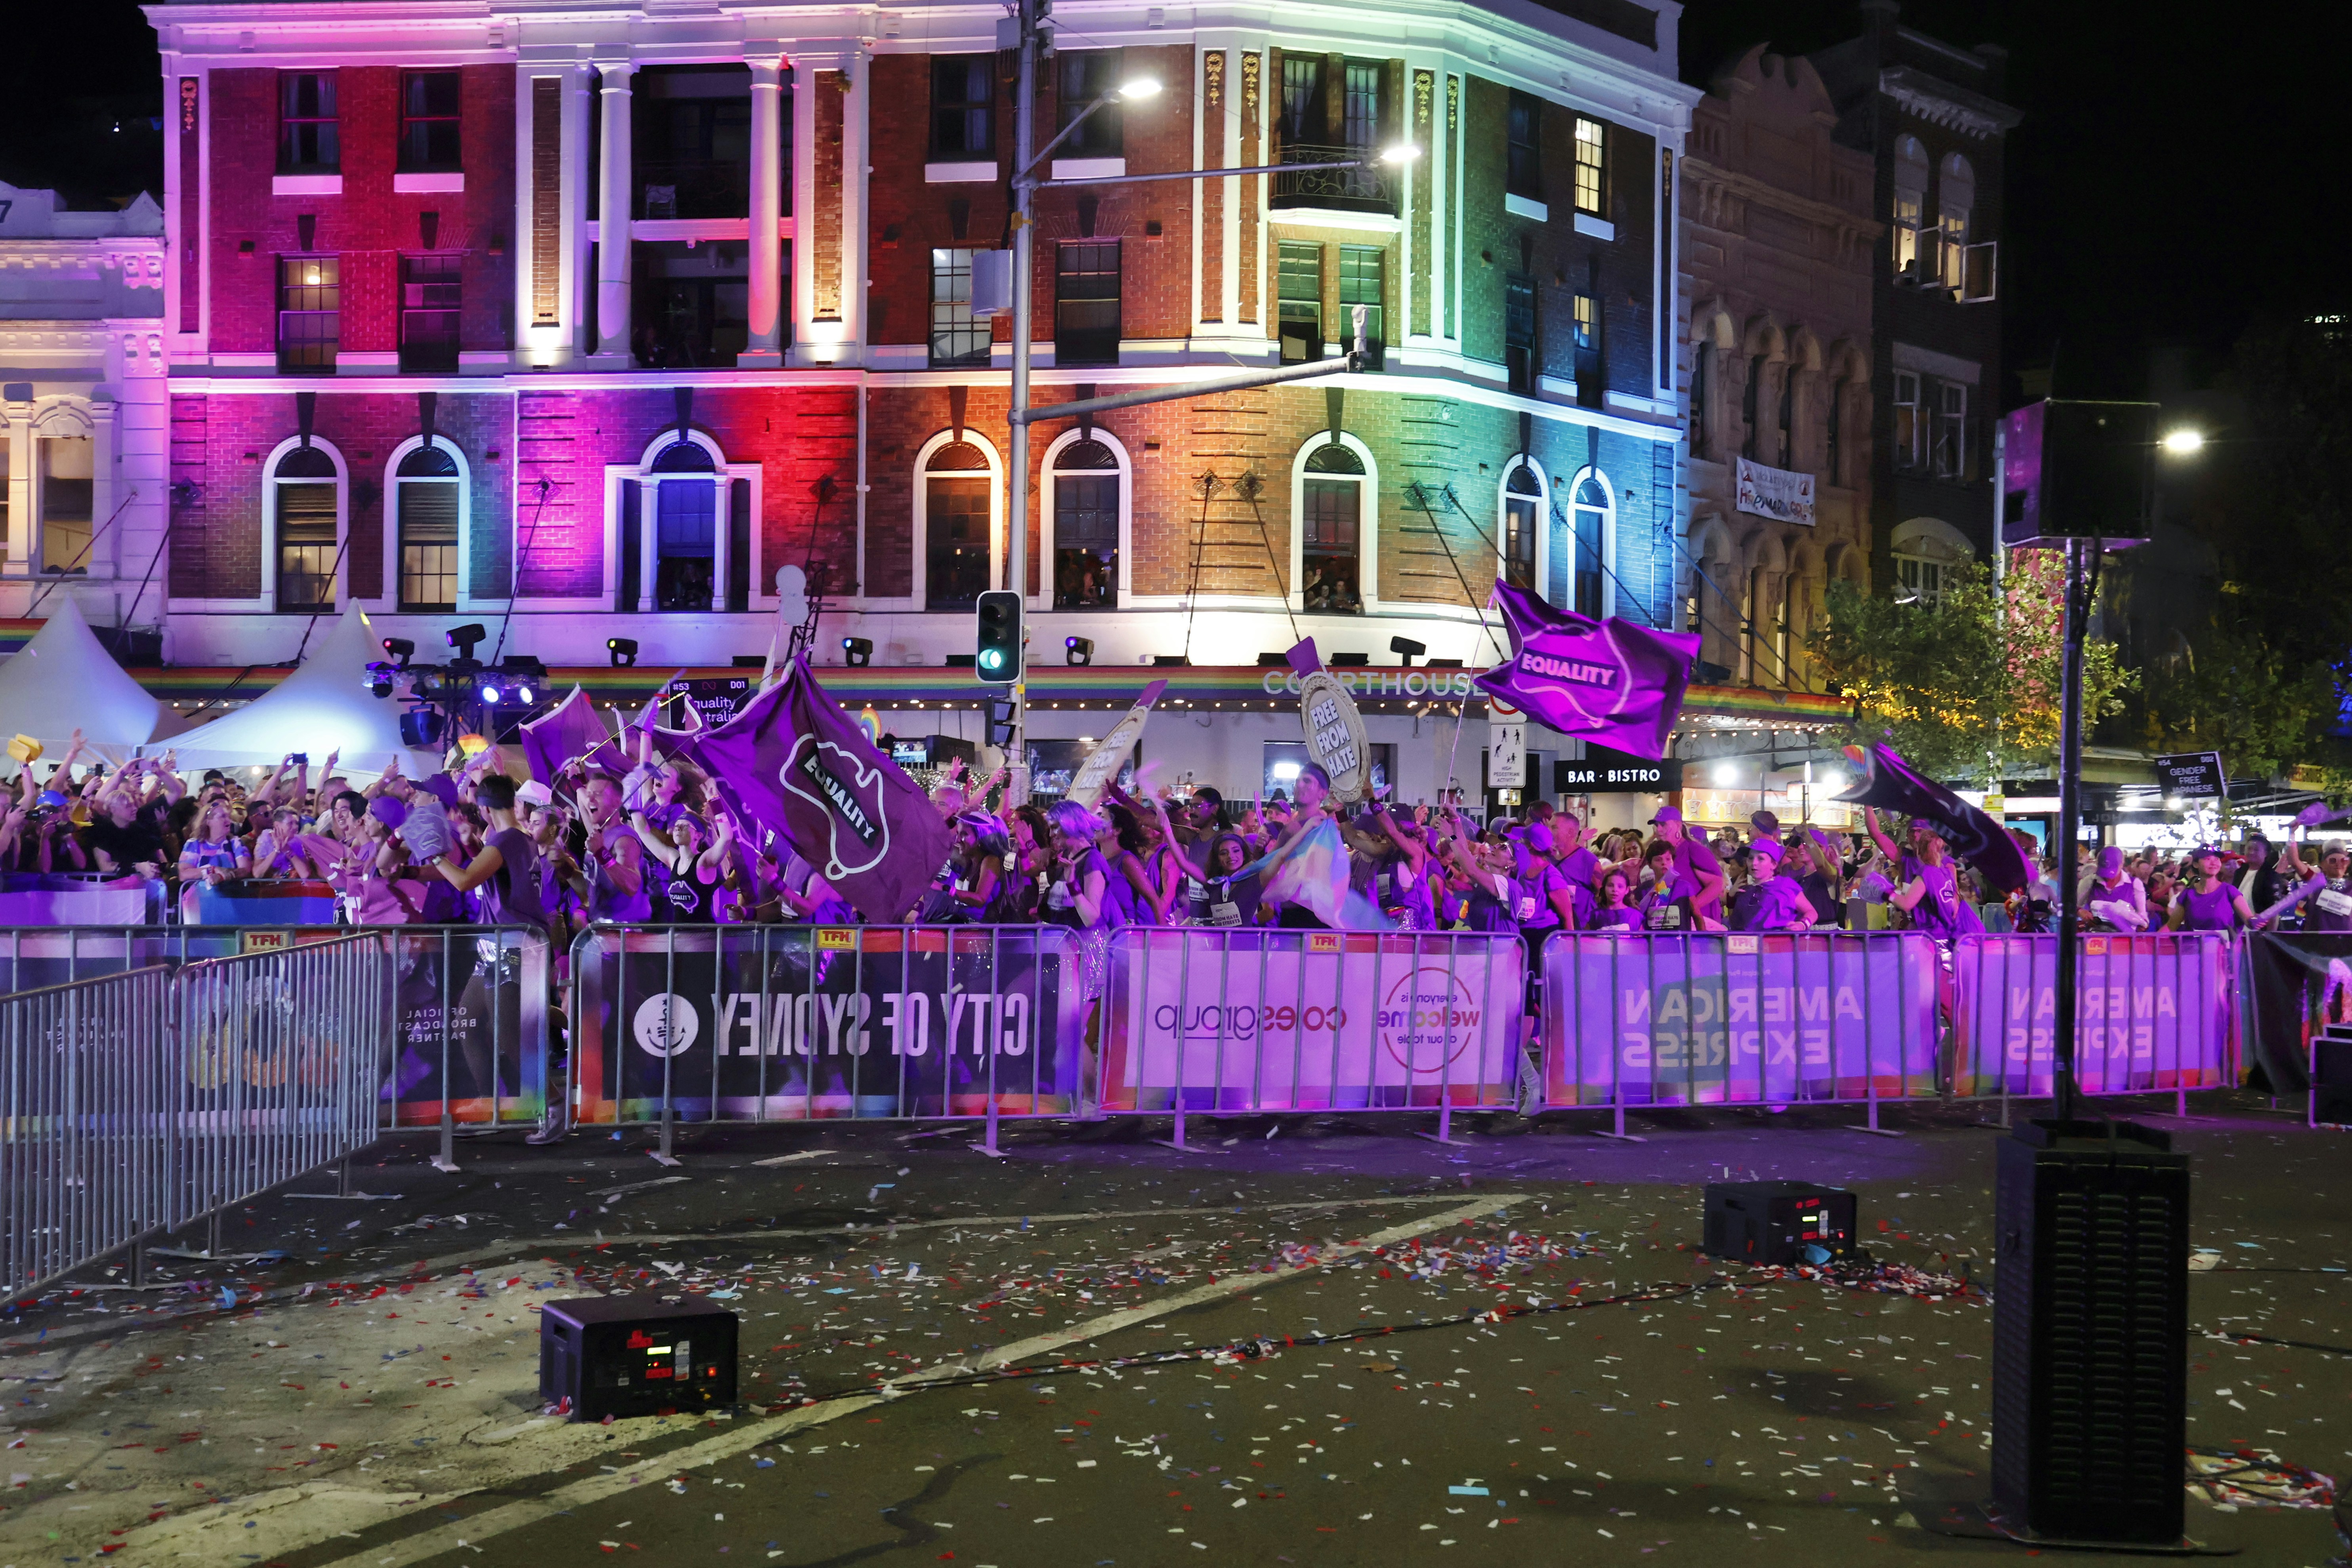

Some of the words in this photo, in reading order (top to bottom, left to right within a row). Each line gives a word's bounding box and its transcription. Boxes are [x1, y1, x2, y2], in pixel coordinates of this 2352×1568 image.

[1521, 653, 1615, 685] EQUALITY
[1263, 671, 1489, 696] CORTHOUSE
[694, 696, 736, 710] quality
[1310, 698, 1339, 731] FREE
[1316, 720, 1351, 756] FROM
[1326, 746, 1357, 778] HATE
[1568, 771, 1595, 783] BAR
[1608, 769, 1661, 782] BISTRO
[2170, 766, 2207, 776] GENDER
[2179, 776, 2201, 784] FREE
[2171, 784, 2214, 794] JAPANESE
[804, 754, 875, 839] EQUALITY
[250, 935, 280, 946] TFH
[822, 931, 850, 942] TFH
[1314, 936, 1336, 946] TFH
